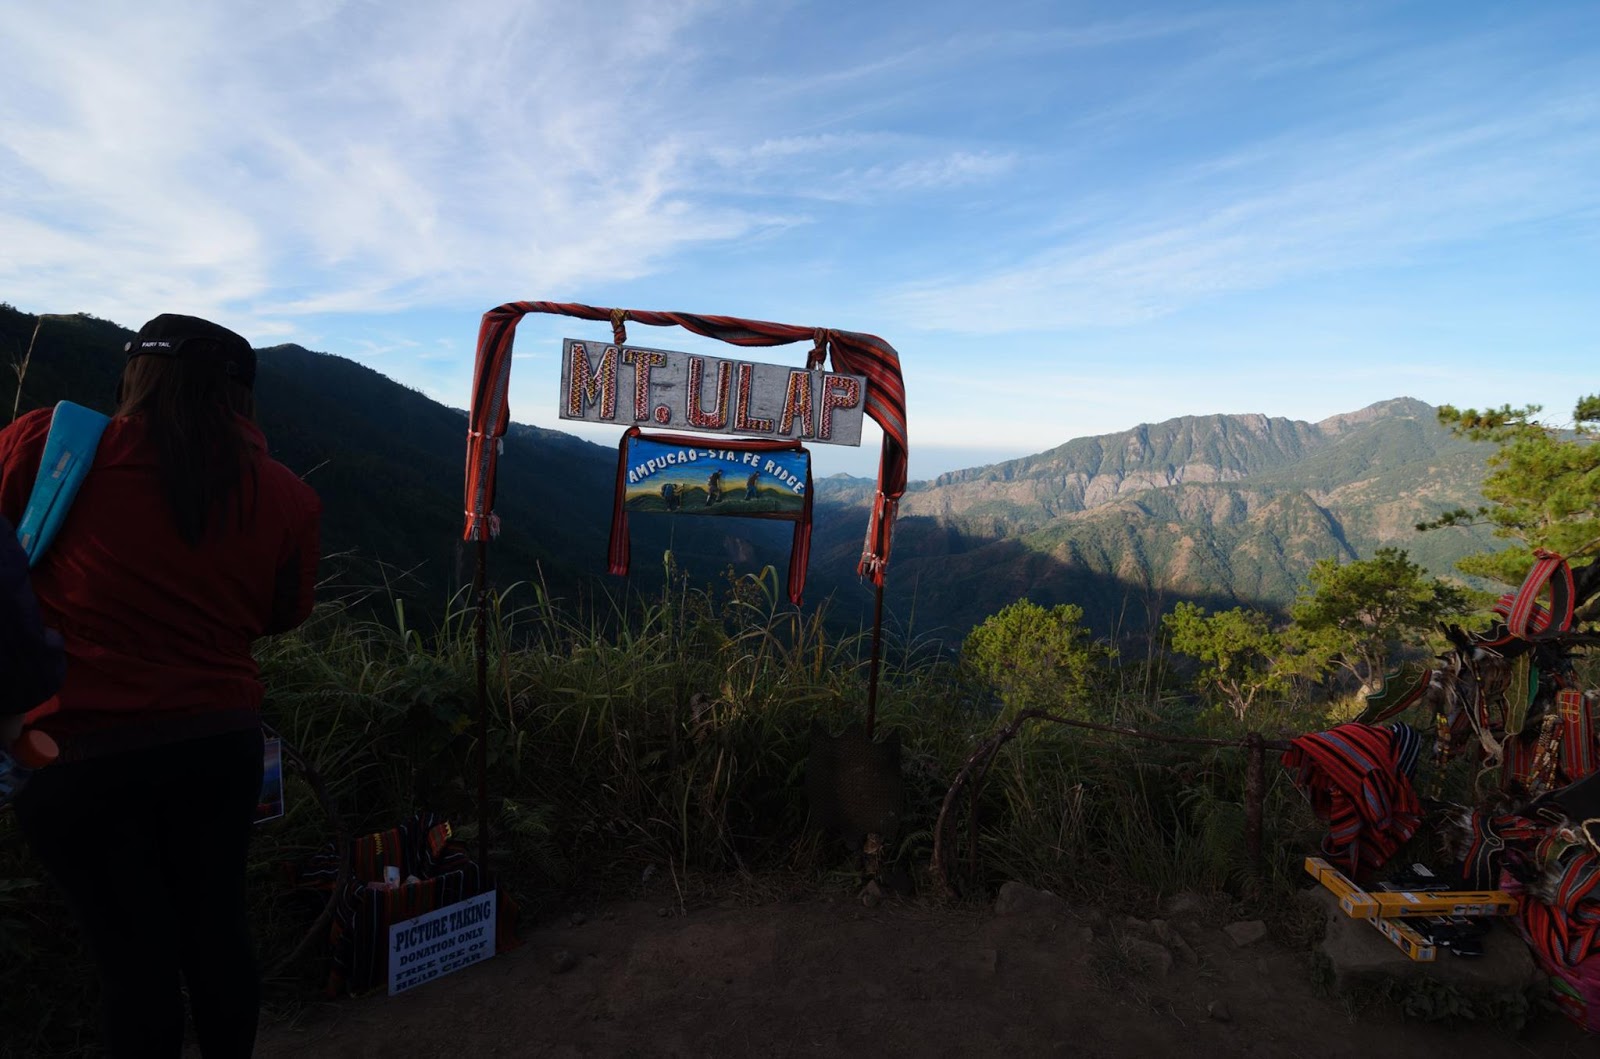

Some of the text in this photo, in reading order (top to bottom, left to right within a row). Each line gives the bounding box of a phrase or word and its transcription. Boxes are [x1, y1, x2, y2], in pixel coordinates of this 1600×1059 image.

[567, 343, 861, 440] MT. ULAP
[743, 452, 761, 468] FE
[764, 459, 805, 494] RIDGE
[395, 901, 491, 952] PICTURE TAKING
[400, 926, 484, 966] DONATION ONLY
[395, 940, 488, 981] FREE USE OF
[395, 970, 438, 992] HEAD
